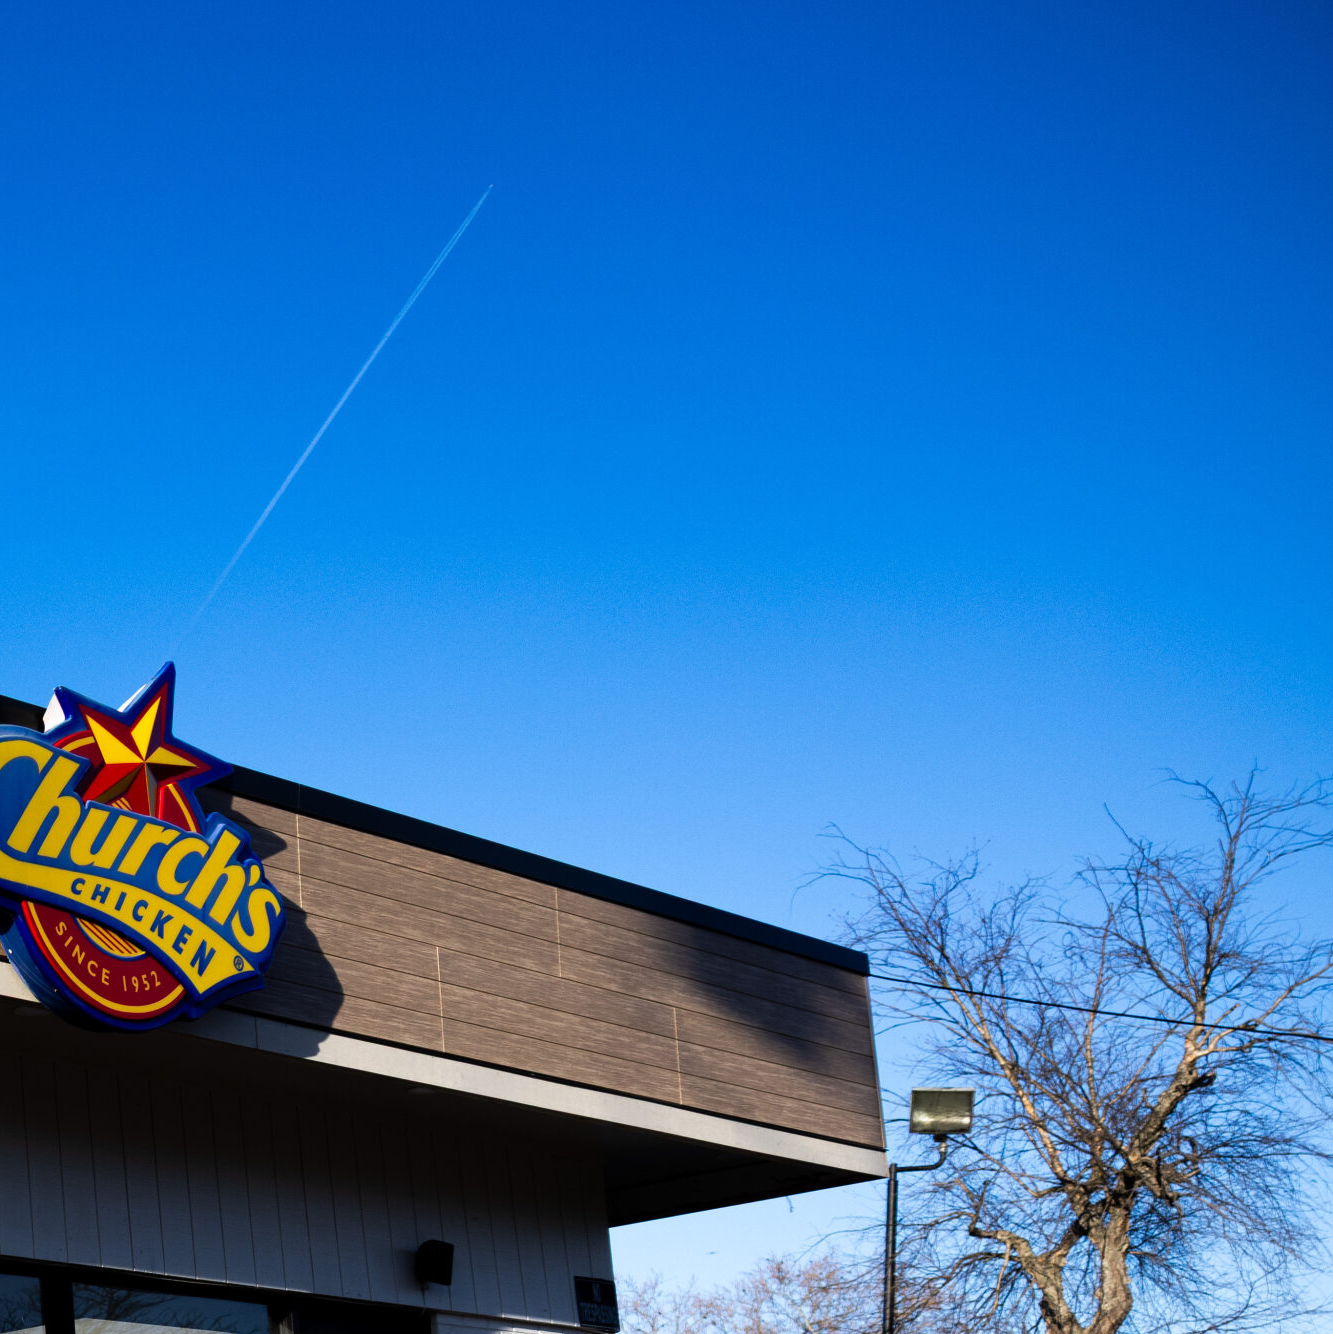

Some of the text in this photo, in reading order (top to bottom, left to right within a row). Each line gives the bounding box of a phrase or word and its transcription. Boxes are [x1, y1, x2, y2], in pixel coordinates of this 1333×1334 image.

[54, 920, 162, 993] SINCE 1952
[71, 876, 216, 978] CHICKEN
